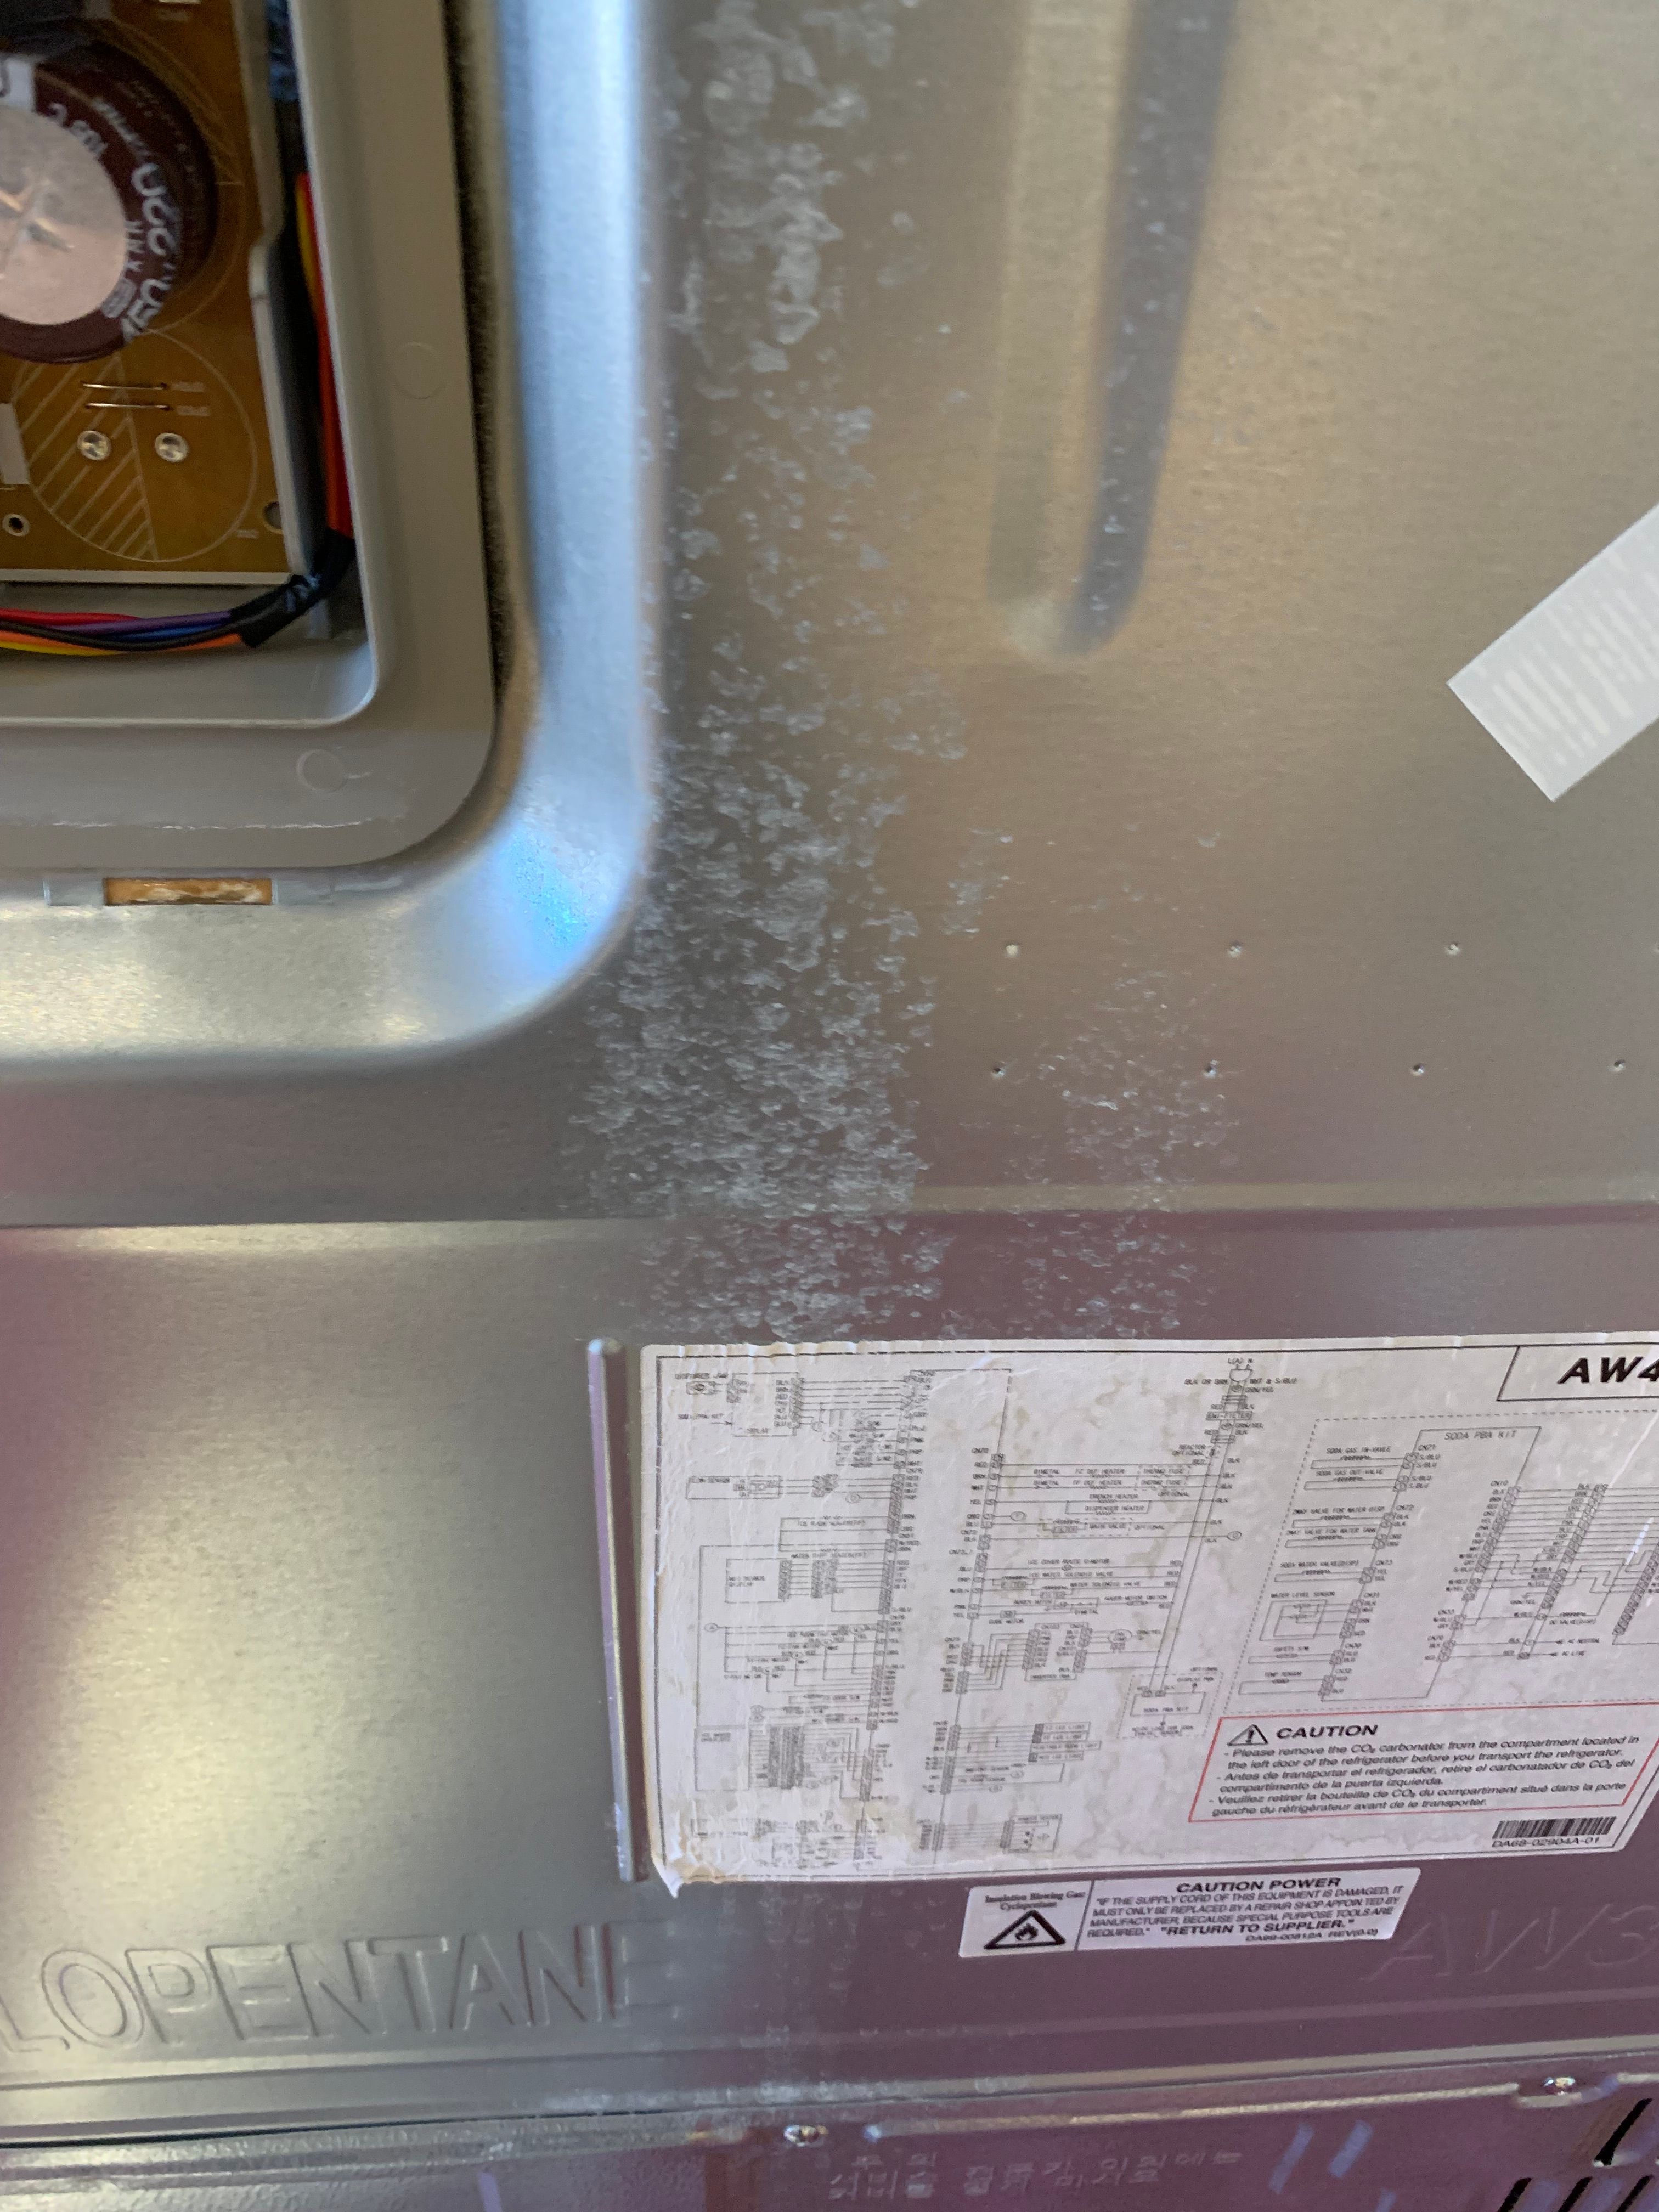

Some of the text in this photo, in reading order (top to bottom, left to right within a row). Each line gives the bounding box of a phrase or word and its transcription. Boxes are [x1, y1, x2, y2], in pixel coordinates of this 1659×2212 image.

[1276, 1724, 1378, 1739] CAUTION
[1233, 1748, 1275, 1757] Please
[1279, 1747, 1325, 1756] remove
[1379, 1743, 1445, 1752] carbonator
[1448, 1741, 1475, 1750] from
[1479, 1740, 1497, 1748] the
[1500, 1738, 1579, 1748] compartment
[1582, 1736, 1627, 1745] located
[1250, 1760, 1269, 1768] left
[1272, 1759, 1300, 1768] door
[1319, 1757, 1338, 1765] the
[1341, 1755, 1408, 1766] refrigerator
[1412, 1754, 1450, 1763] before
[1453, 1754, 1475, 1763] you
[1479, 1752, 1532, 1761] transport
[1534, 1750, 1553, 1759] the
[1224, 1772, 1260, 1780] Antes
[1263, 1771, 1279, 1779] de
[1282, 1769, 1348, 1779] transportar
[1351, 1768, 1362, 1776] el
[1441, 1764, 1472, 1773] retire
[1475, 1763, 1487, 1771] el
[1489, 1761, 1568, 1771] carbonatador
[1570, 1760, 1585, 1769] de
[1616, 1759, 1635, 1768] del
[1220, 1782, 1310, 1792] compartimento
[1312, 1780, 1328, 1788] de
[1331, 1780, 1342, 1788] la
[1345, 1779, 1384, 1788] puerta
[1218, 1795, 1265, 1804] Veuillez
[1267, 1793, 1304, 1802] retirer
[1306, 1792, 1317, 1800] la
[1320, 1791, 1370, 1800] bouteille
[1437, 1786, 1518, 1796] compartiment
[1551, 1784, 1580, 1792] dans
[1595, 1783, 1626, 1792] porte
[1212, 1806, 1256, 1816] gauche
[1389, 1801, 1404, 1809] de
[1176, 1877, 1341, 1892] CAUTION POWER
[1112, 1897, 1132, 1905] THE
[1136, 1895, 1177, 1904] SUPPLY
[1180, 1894, 1211, 1903] CORD
[1214, 1894, 1228, 1902] OF
[1232, 1893, 1255, 1901] THIS
[1258, 1889, 1320, 1900] EQUIPMENT
[1323, 1889, 1332, 1897] IS
[1393, 1886, 1404, 1894] IT
[1093, 1907, 1122, 1916] MUST
[1126, 1905, 1154, 1915] ONLY
[1154, 1905, 1167, 1914] BE
[1171, 1904, 1227, 1914] REPLACED
[1229, 1903, 1243, 1912] BY
[1244, 1903, 1251, 1911] A
[1254, 1901, 1291, 1910] REPAIR
[1294, 1900, 1323, 1910] SHOP
[1183, 1915, 1233, 1923] BECAUSE
[1235, 1914, 1279, 1922] SPECIAL
[1282, 1910, 1333, 1921] PURPOSE
[1239, 1923, 1260, 1933] TO
